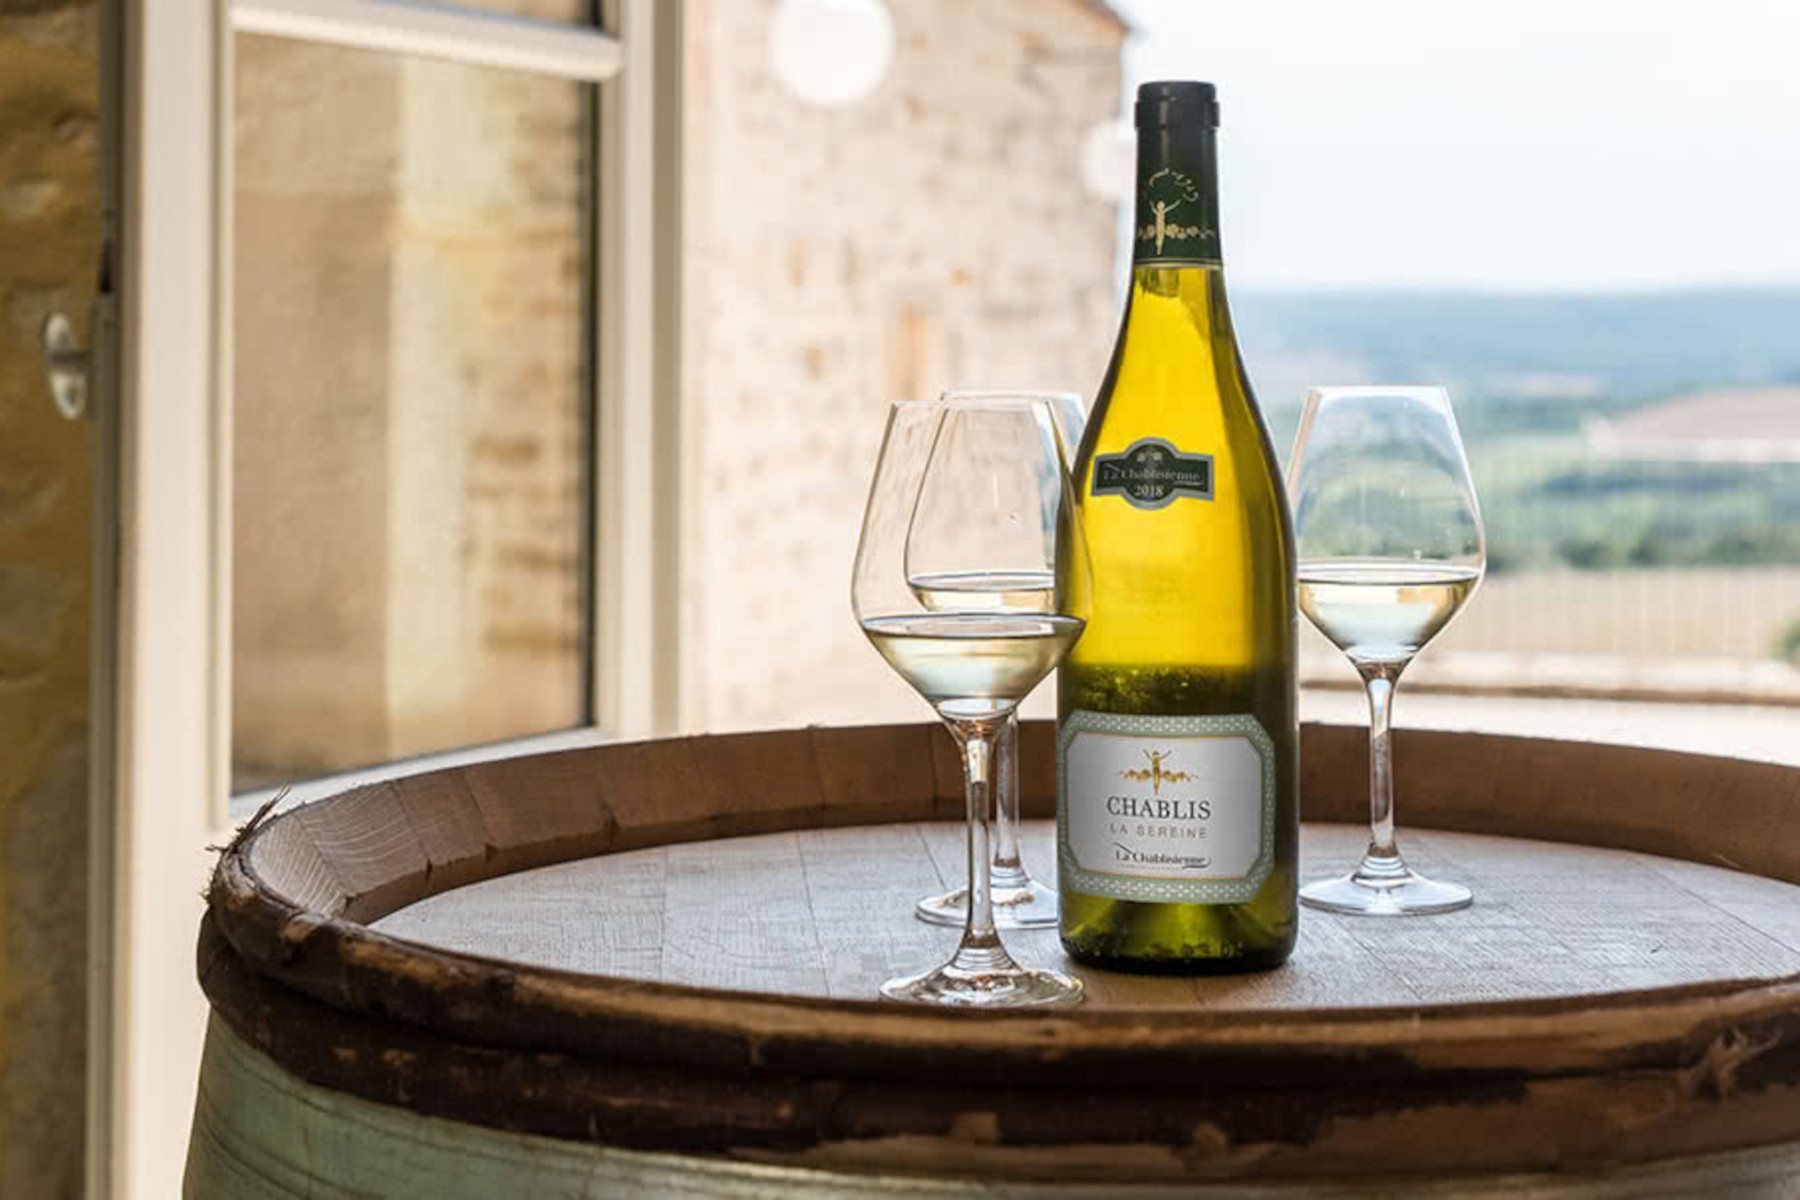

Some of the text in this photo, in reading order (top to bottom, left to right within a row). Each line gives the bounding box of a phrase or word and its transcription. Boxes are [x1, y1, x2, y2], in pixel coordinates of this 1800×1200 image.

[1133, 483, 1165, 498] 2018
[1107, 796, 1211, 820] CHABLIS
[1110, 823, 1207, 839] LA SEREINE
